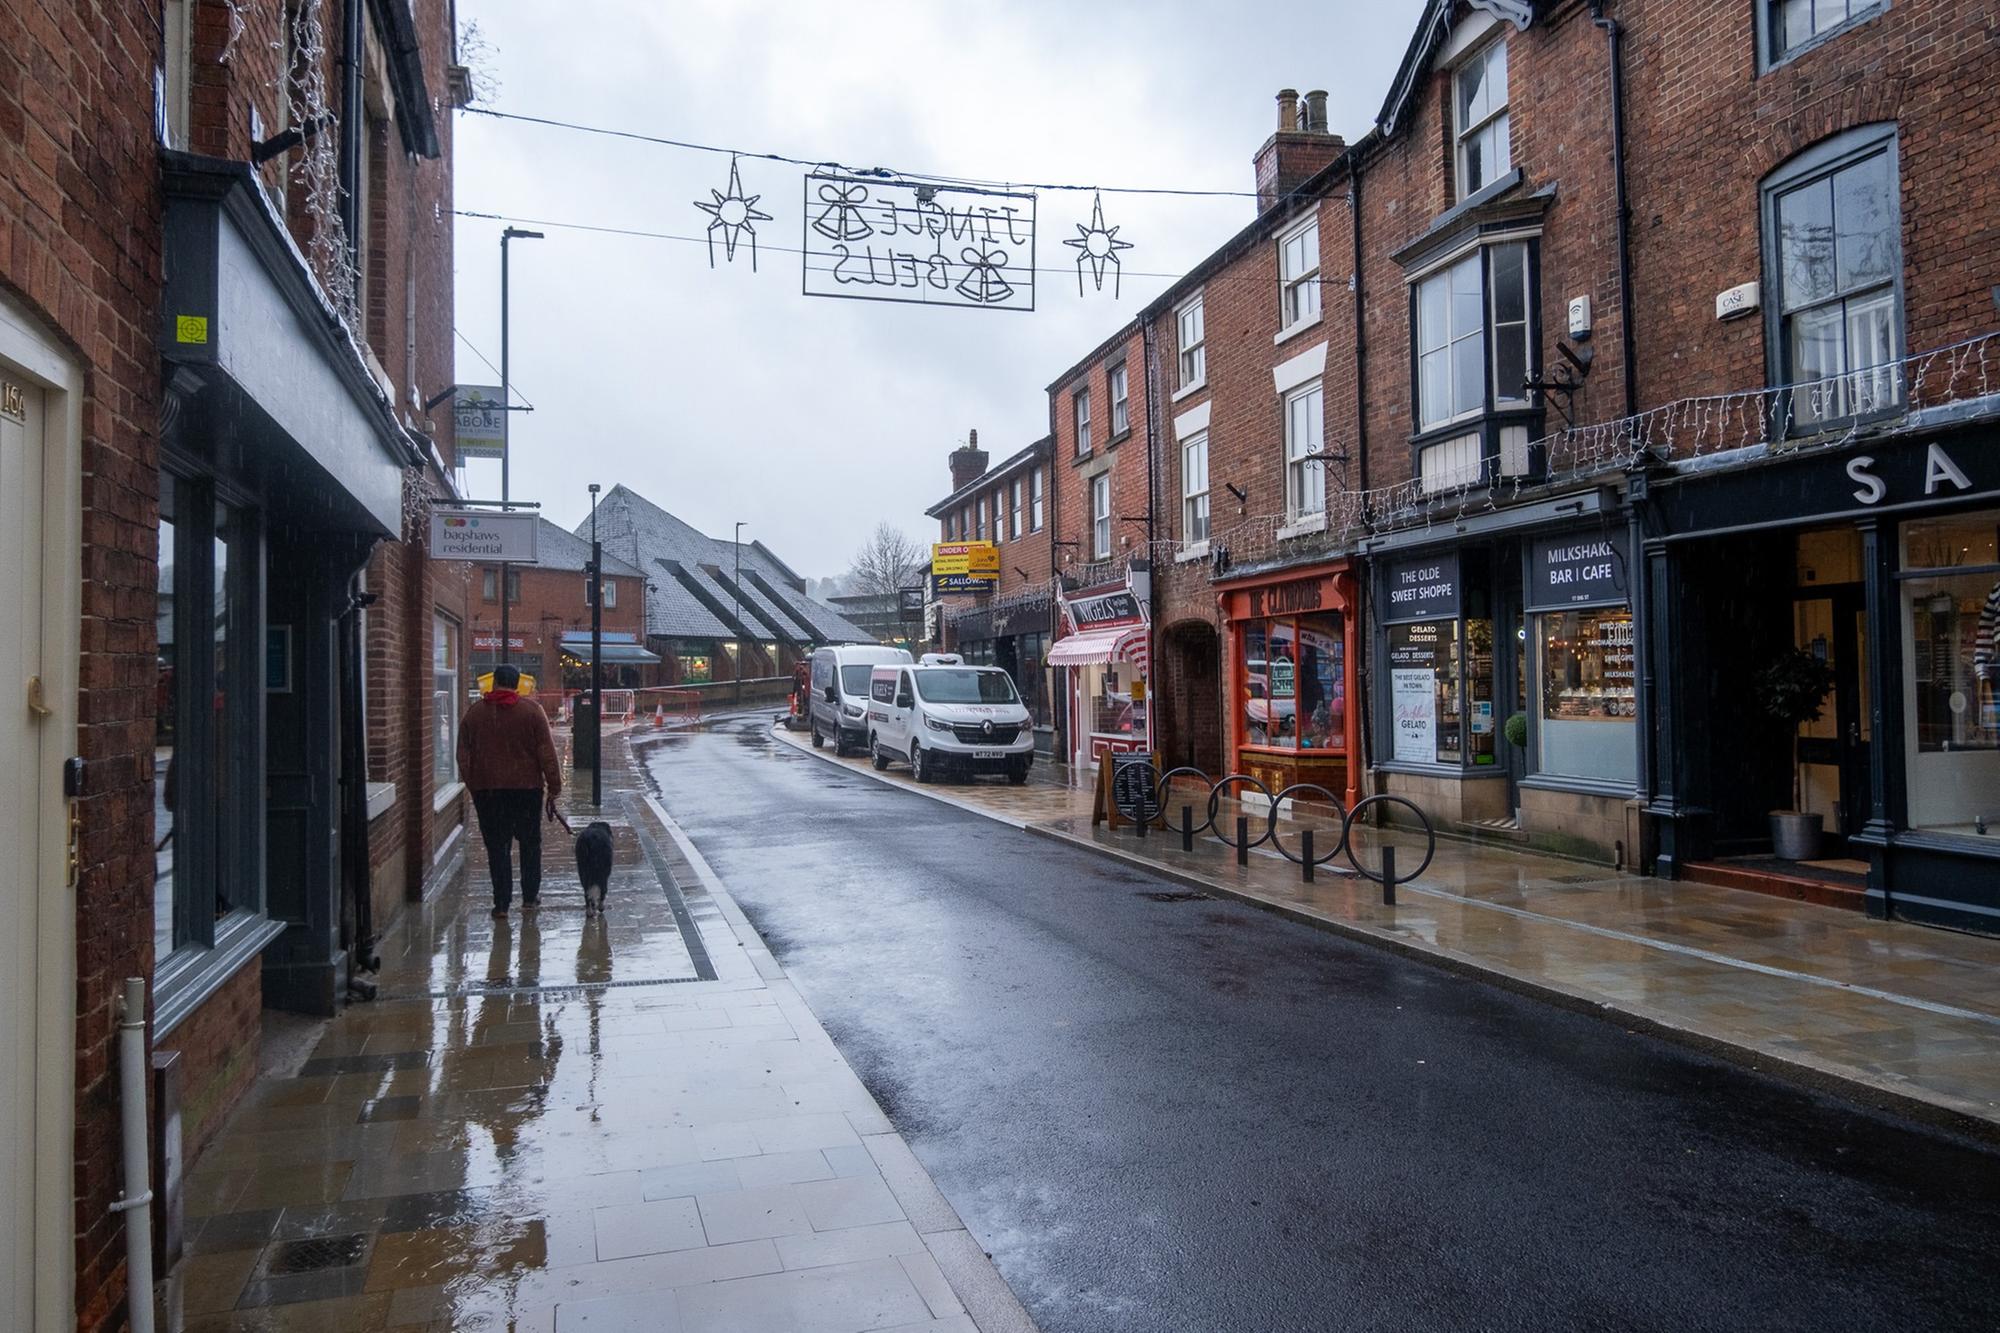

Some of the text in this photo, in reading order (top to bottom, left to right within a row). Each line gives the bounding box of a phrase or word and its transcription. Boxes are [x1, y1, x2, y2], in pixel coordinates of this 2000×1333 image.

[455, 415, 501, 429] ABODE
[443, 528, 501, 542] bagshaws
[443, 542, 503, 554] residential
[938, 546, 963, 555] UNDER
[1547, 541, 1613, 564] MILKSHAKE
[1401, 566, 1440, 584] THE OLDE
[1550, 568, 1573, 584] BAR
[1582, 563, 1612, 580] CAFE
[949, 576, 988, 586] SALLOWA
[1391, 583, 1453, 603] SWEET SHOPPE
[1078, 598, 1115, 622] NIGELS
[1410, 625, 1437, 634] GELATO
[1408, 634, 1438, 642] DESSERTS
[1391, 651, 1435, 660] GELATO DESSERTS
[1401, 719, 1427, 729] GELATO
